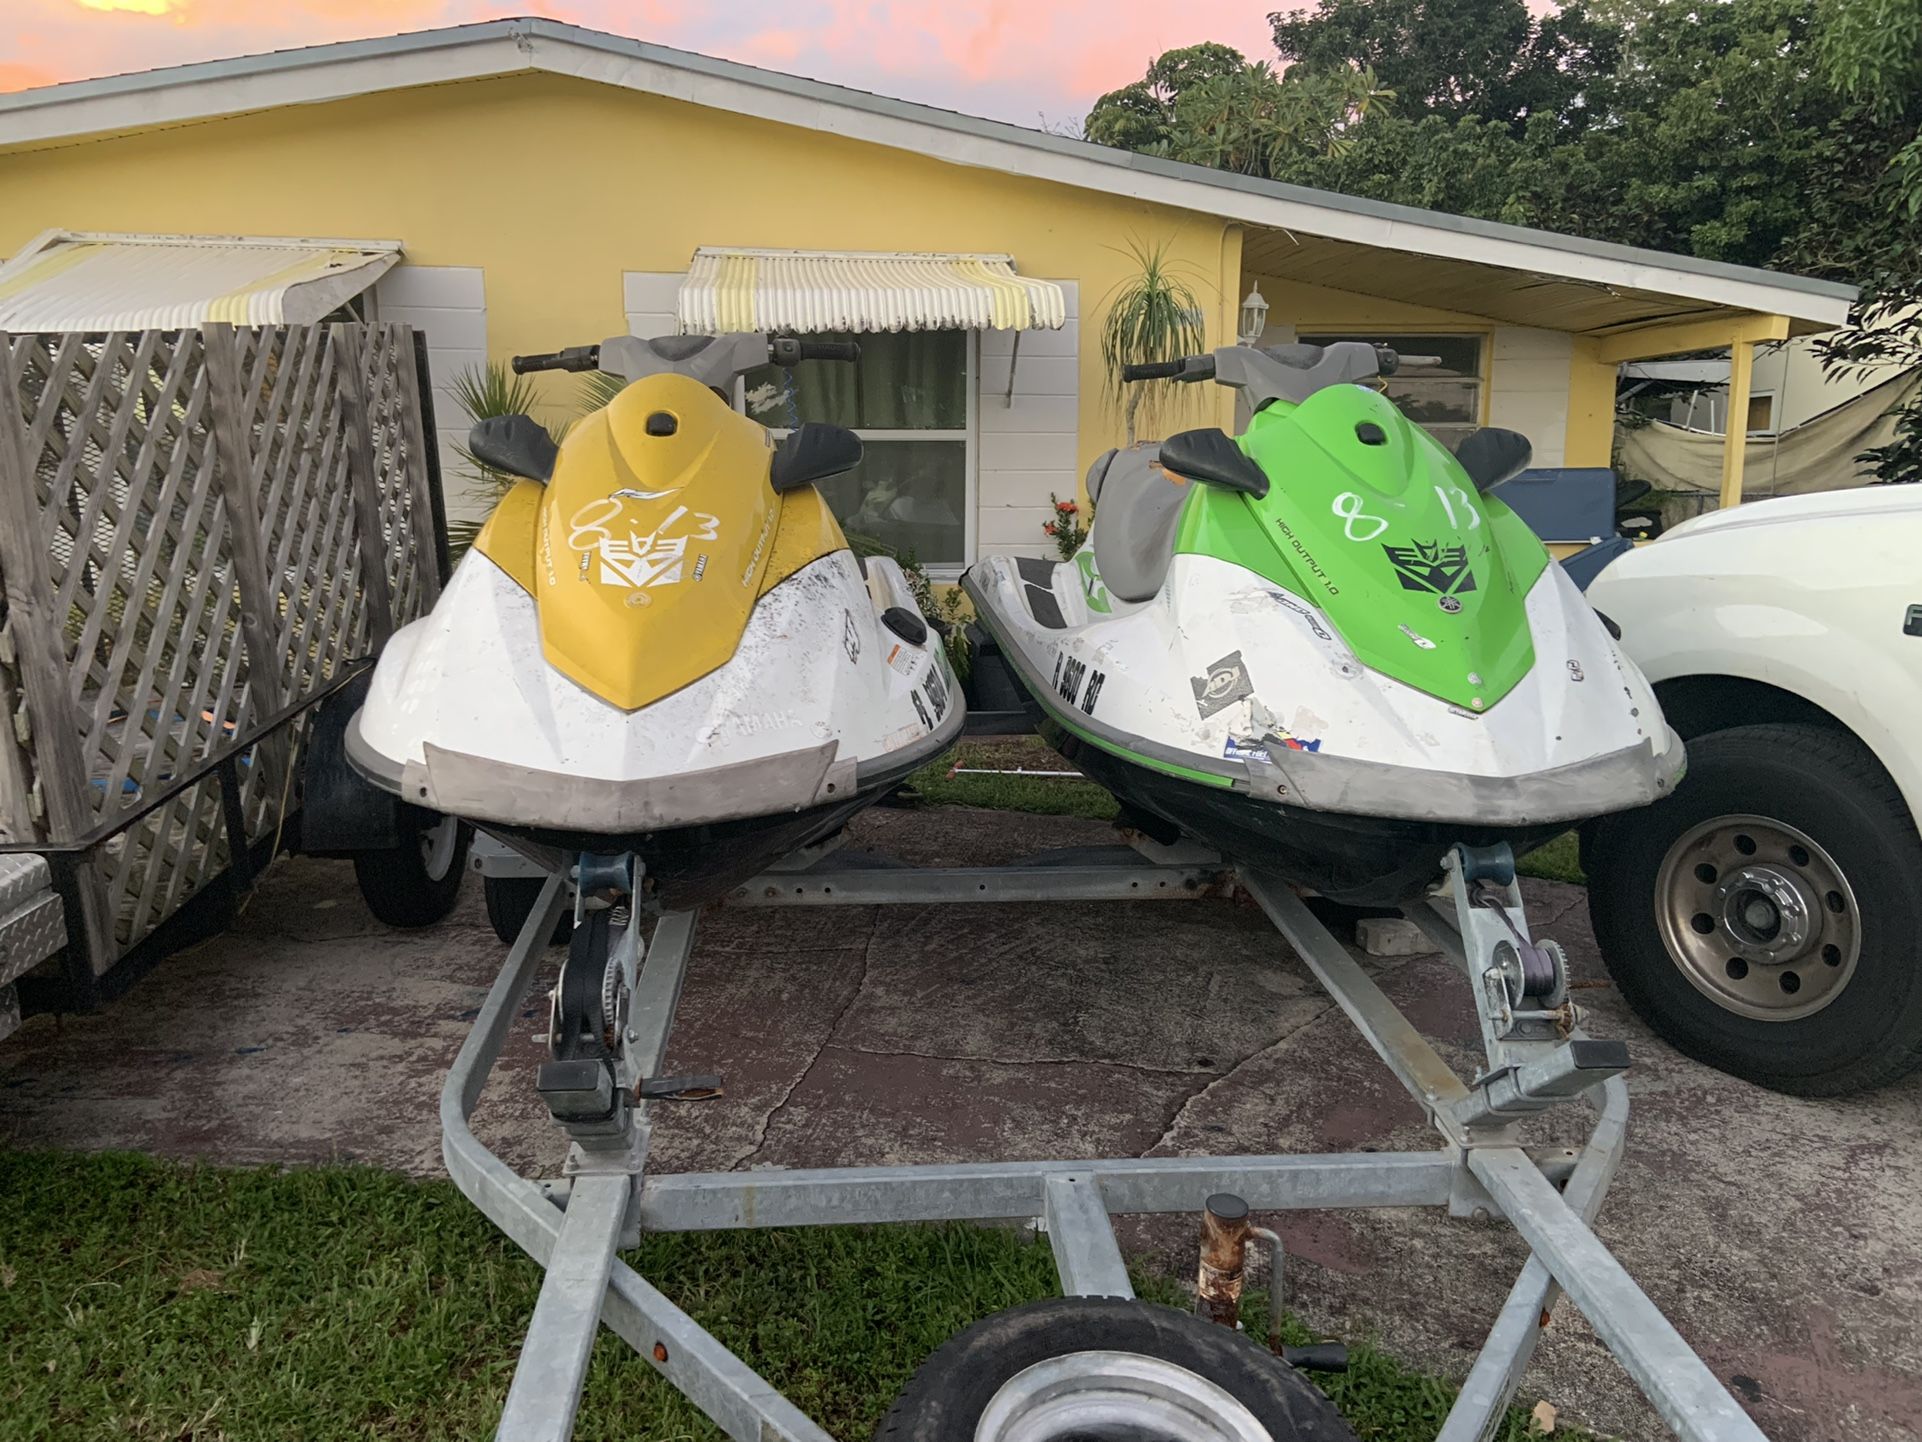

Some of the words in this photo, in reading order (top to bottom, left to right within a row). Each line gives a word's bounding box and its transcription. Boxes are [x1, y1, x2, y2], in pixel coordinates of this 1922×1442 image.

[1275, 518, 1294, 540] HIGH
[1292, 539, 1327, 580] OUTPUT
[1324, 580, 1340, 596] 1.0
